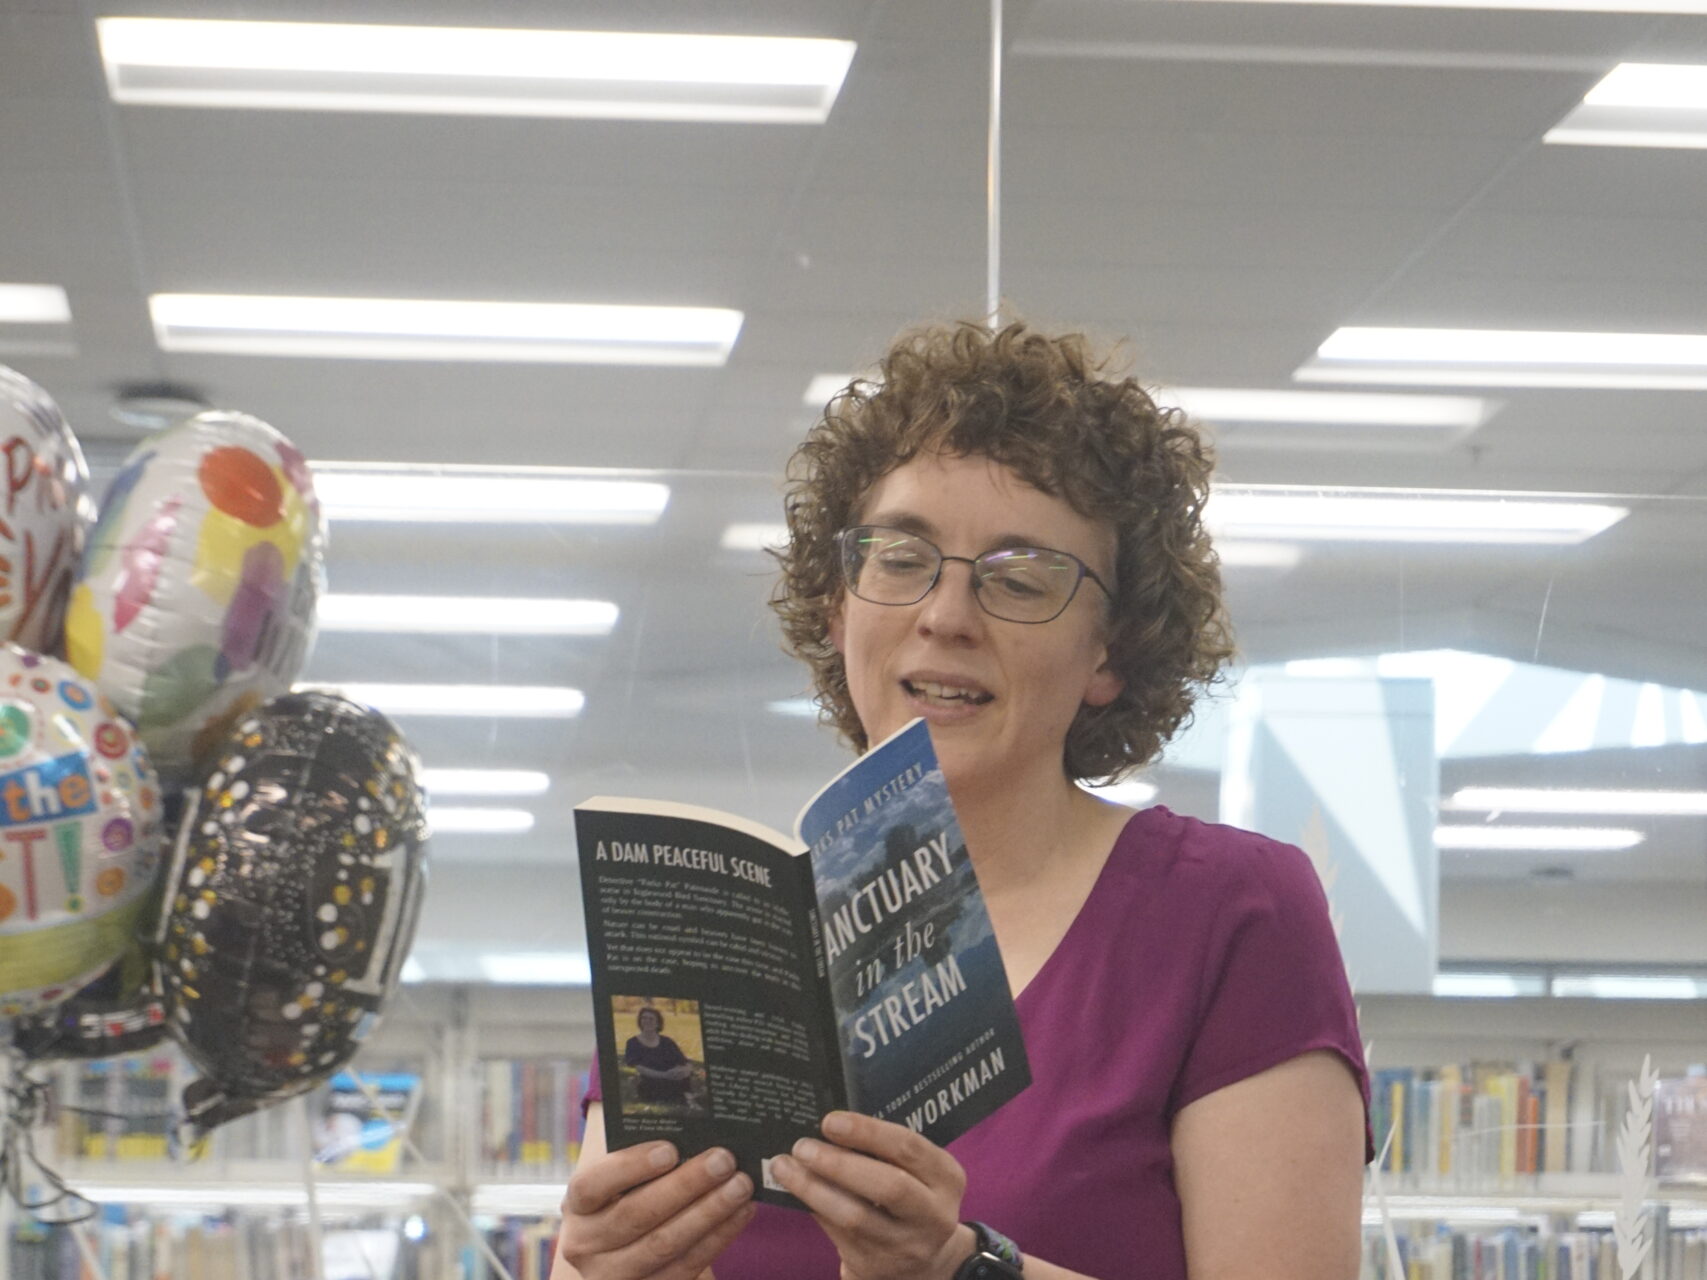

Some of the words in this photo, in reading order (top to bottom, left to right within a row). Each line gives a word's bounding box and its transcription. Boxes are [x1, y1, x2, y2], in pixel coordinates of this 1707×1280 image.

[4, 770, 92, 822] the
[836, 808, 859, 835] PAT
[863, 762, 923, 816] MYSTERY
[596, 841, 608, 861] A
[611, 841, 649, 863] DAM
[653, 844, 729, 875] PEACEFUL
[730, 857, 773, 888] SCENE
[856, 958, 881, 997] in
[894, 921, 935, 969] the
[855, 955, 967, 1059] STREAM
[886, 1090, 912, 1114] TODAY
[913, 1052, 964, 1094] BESTSELLING
[965, 1028, 996, 1055] AUTHOR
[905, 1046, 1006, 1133] WORKMAN
